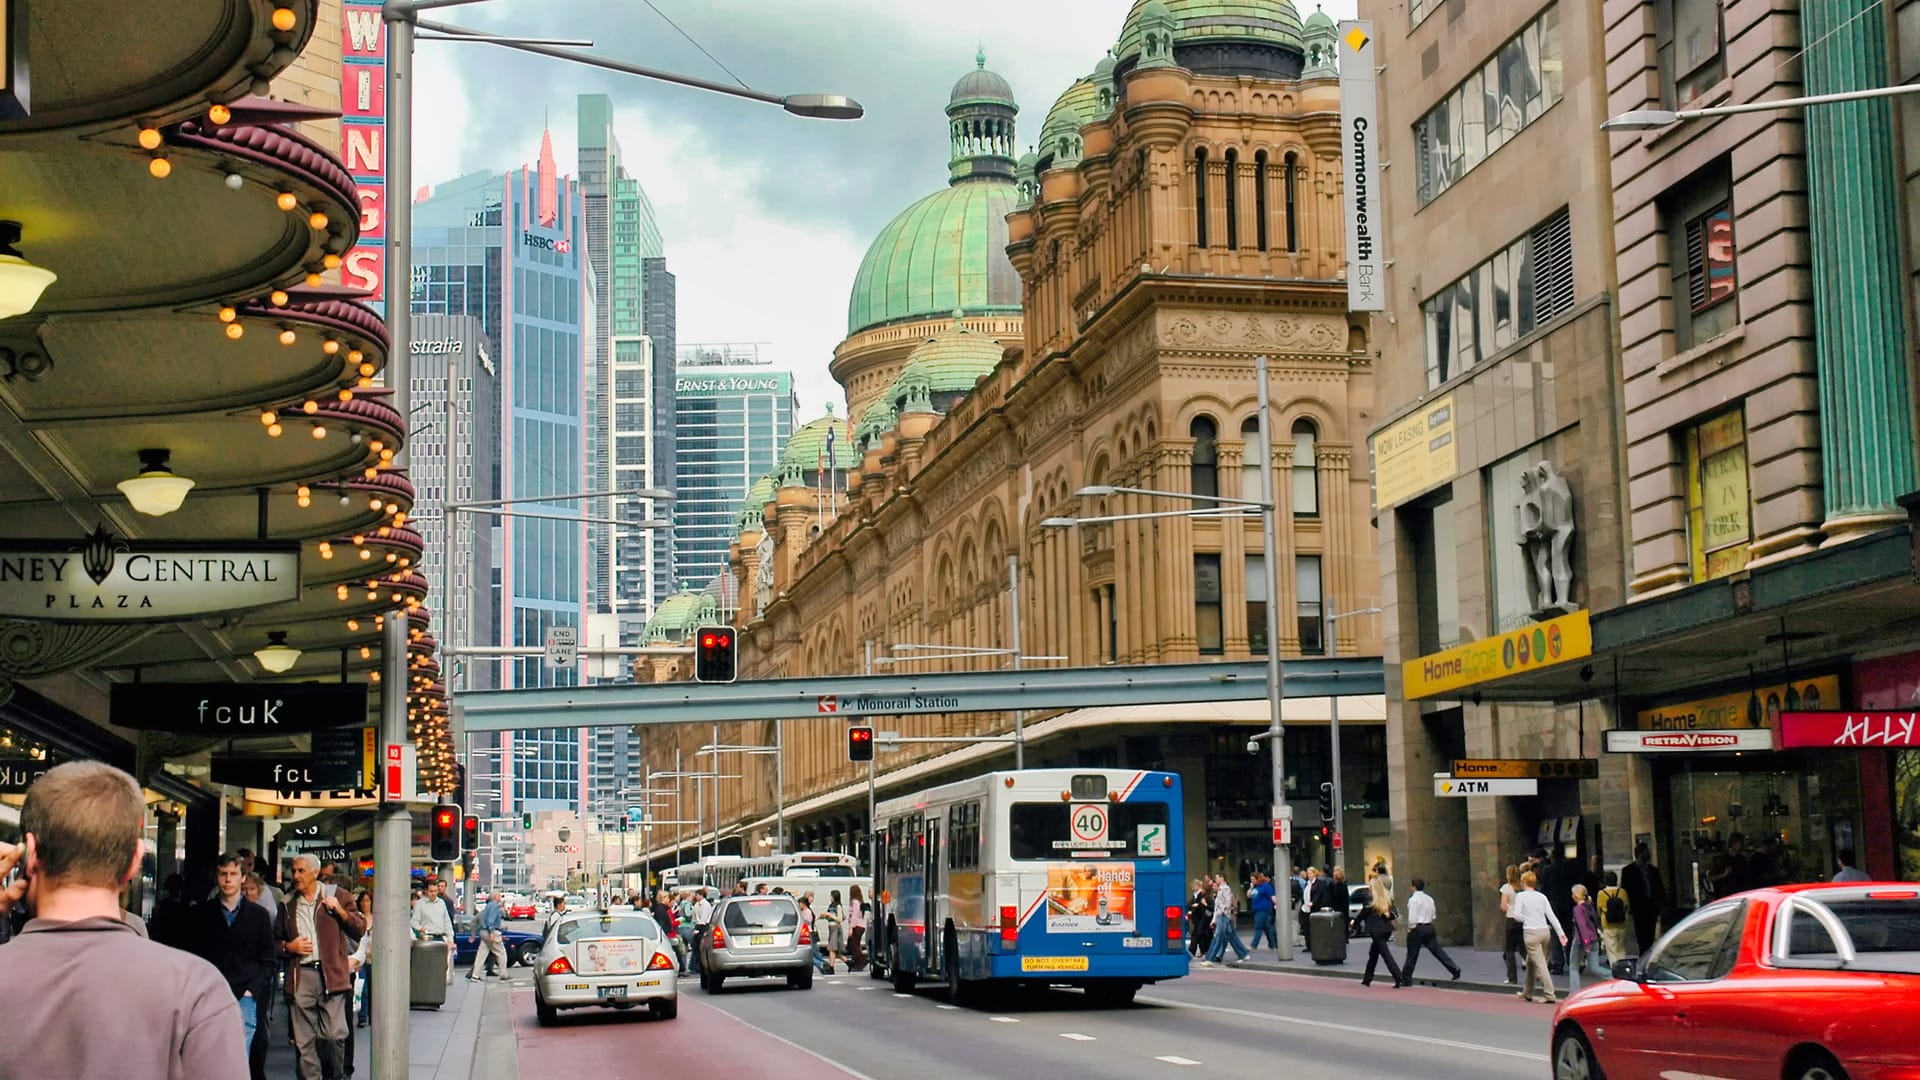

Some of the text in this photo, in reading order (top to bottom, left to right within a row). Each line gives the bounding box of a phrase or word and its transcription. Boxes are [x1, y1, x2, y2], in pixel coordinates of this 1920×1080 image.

[1353, 116, 1374, 302] Commonwealth Bank
[524, 233, 554, 250] HSBC
[410, 337, 463, 354] stralia
[676, 376, 778, 391] ERNST & YOUNG
[1378, 420, 1424, 457] NOW LEASING
[125, 555, 278, 582] CENTRAL
[45, 594, 153, 608] PLAZA
[857, 696, 959, 711] Monorail Station
[1834, 713, 1916, 745] ALLY
[1645, 733, 1735, 747] RETRAVISION
[1457, 782, 1489, 793] ATM
[1076, 814, 1103, 832] 40
[1097, 869, 1131, 881] Hands
[1097, 881, 1113, 895] off
